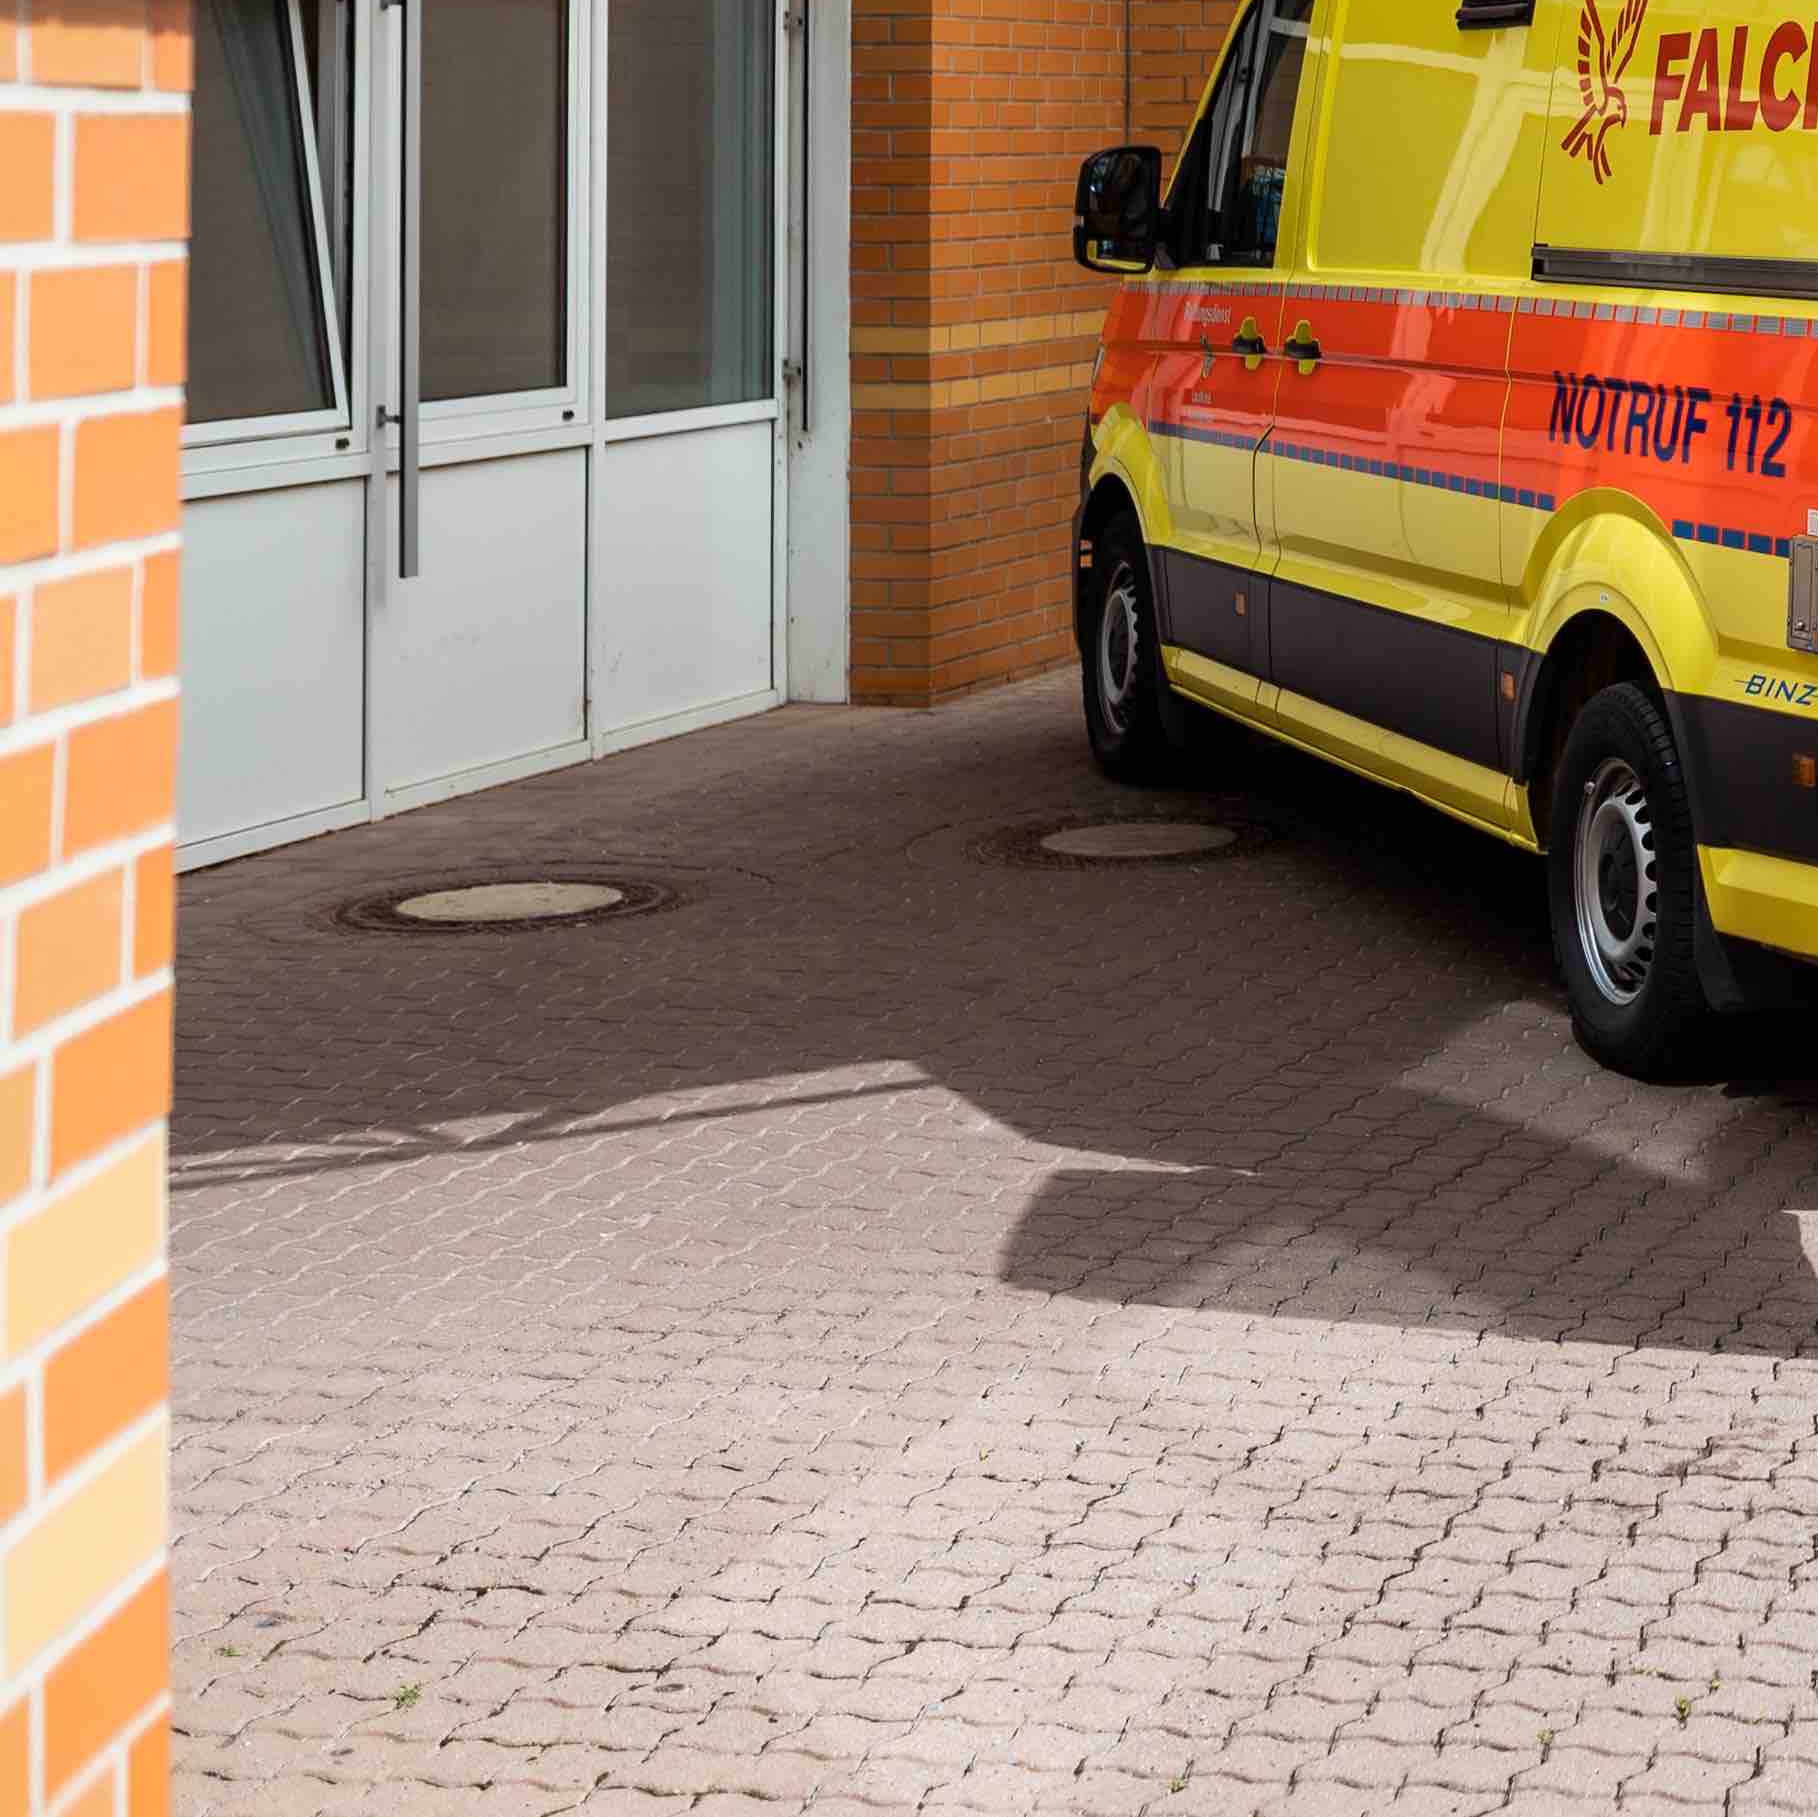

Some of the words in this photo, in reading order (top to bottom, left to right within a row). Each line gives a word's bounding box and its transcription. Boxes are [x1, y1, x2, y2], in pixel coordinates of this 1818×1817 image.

[1547, 369, 1712, 464] NOTRUF
[1725, 392, 1793, 479] 112
[1744, 673, 1818, 706] BINZ
